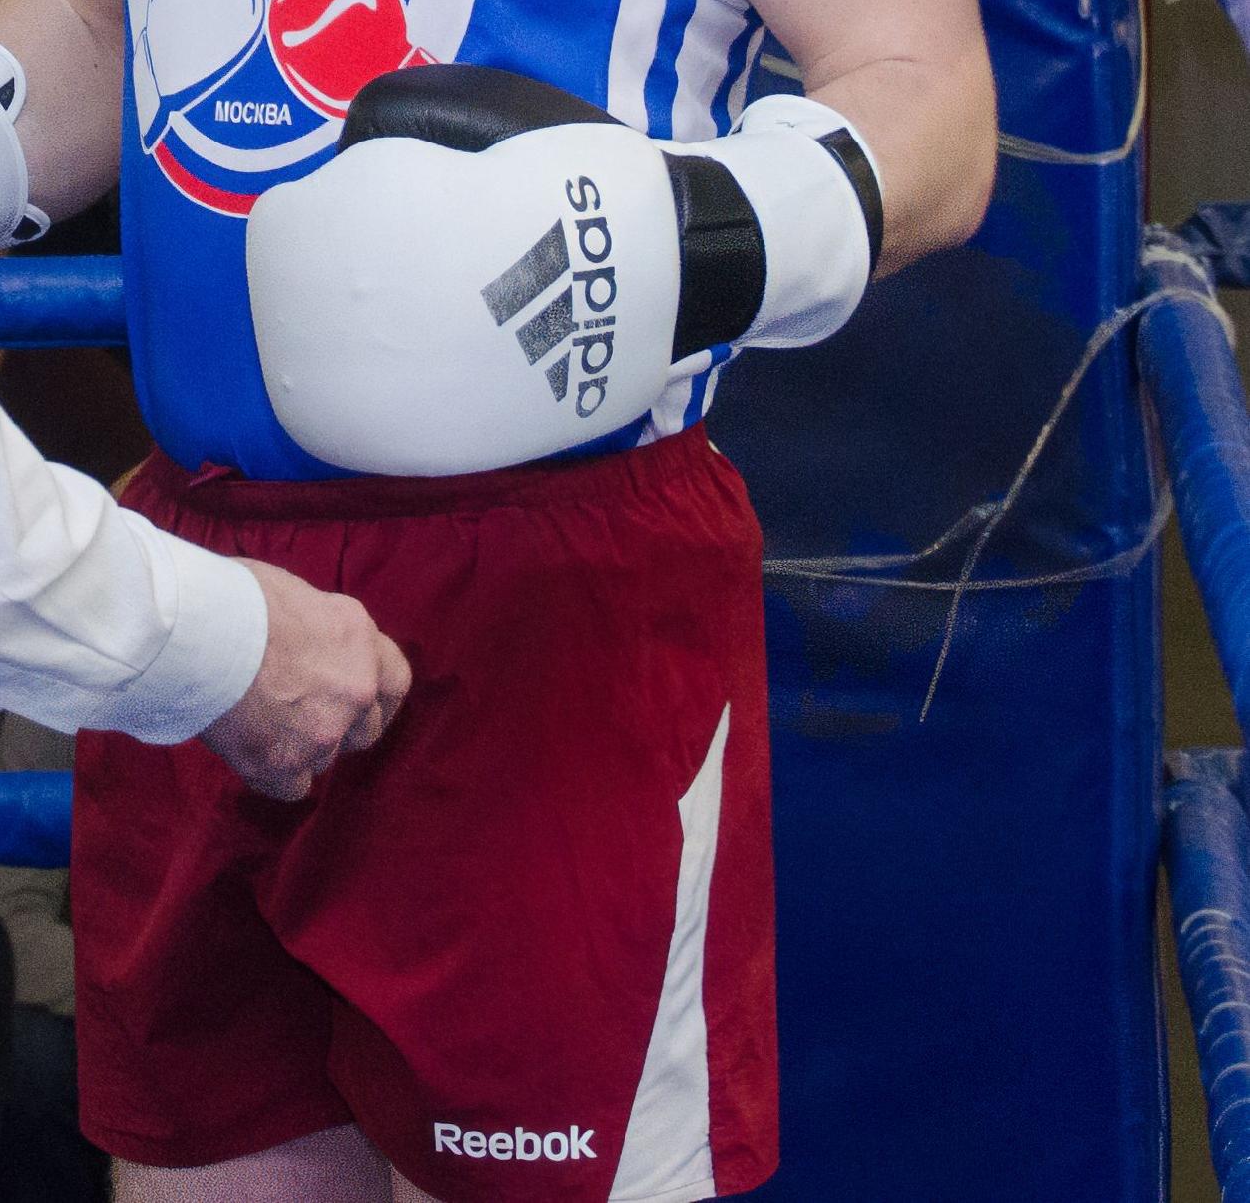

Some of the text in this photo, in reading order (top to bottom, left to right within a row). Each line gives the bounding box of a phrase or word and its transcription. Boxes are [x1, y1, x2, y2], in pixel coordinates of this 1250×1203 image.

[214, 100, 293, 126] МОСКВА
[565, 174, 617, 419] adidas
[433, 1121, 598, 1162] Reebok
